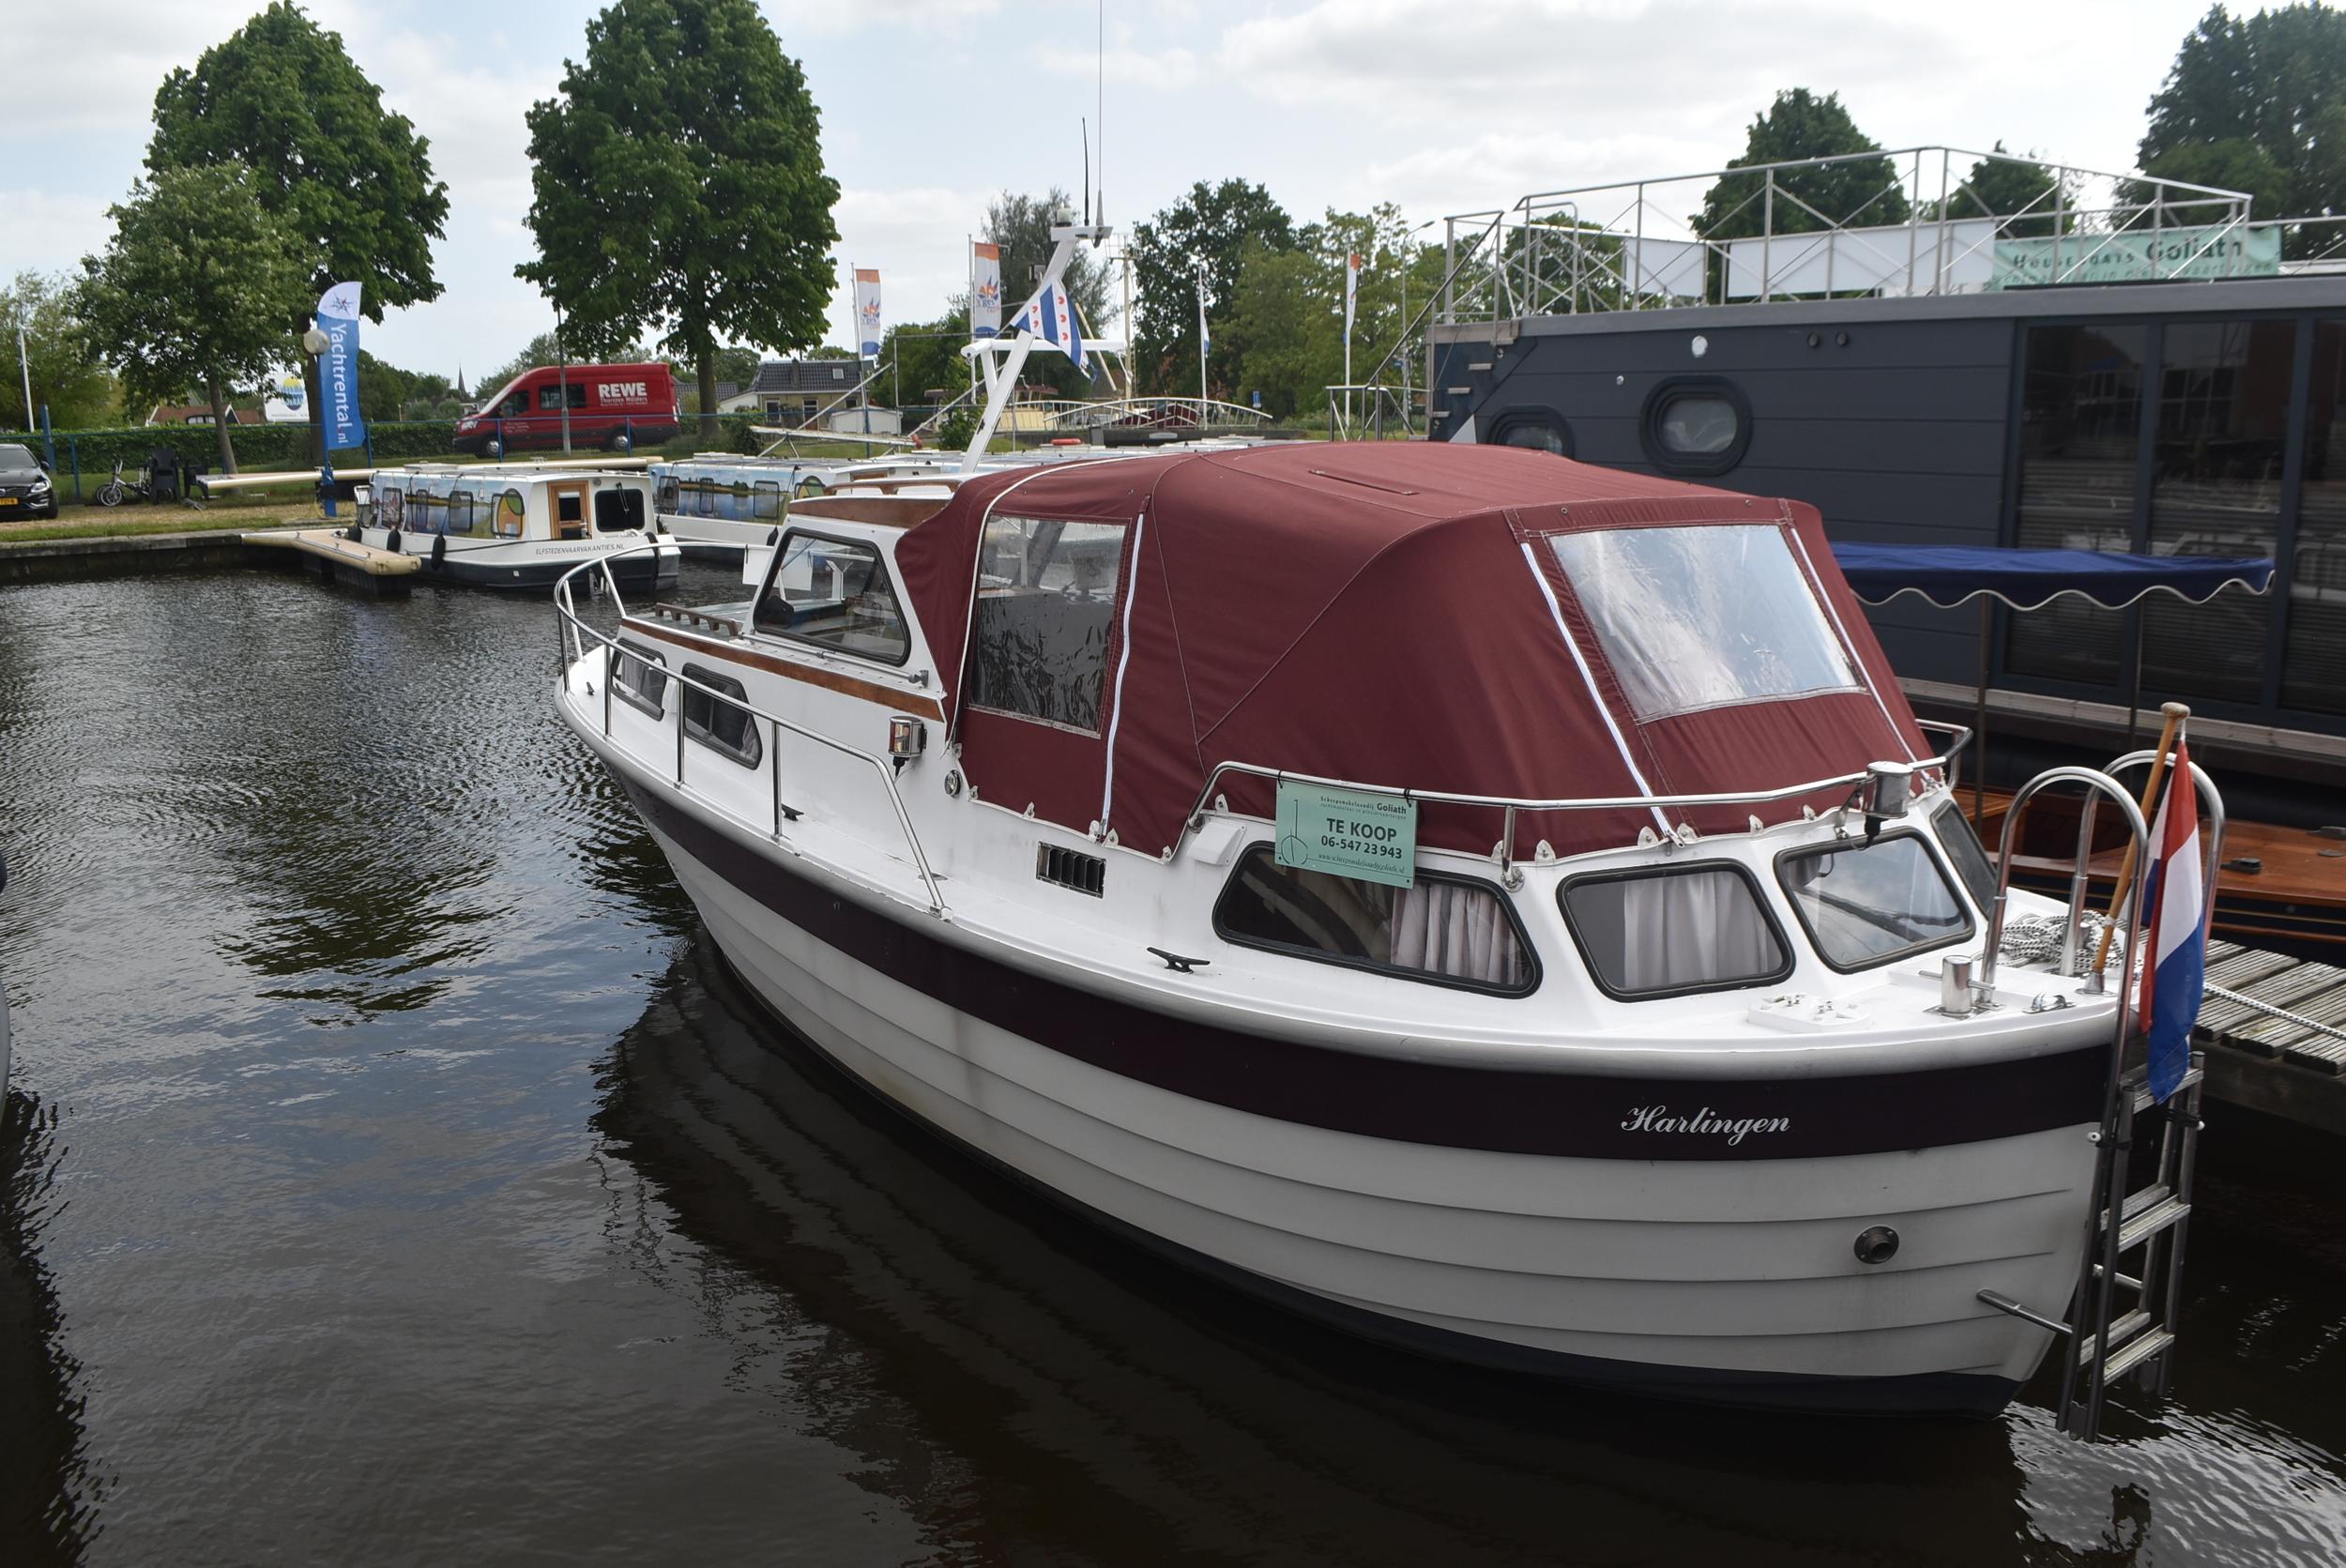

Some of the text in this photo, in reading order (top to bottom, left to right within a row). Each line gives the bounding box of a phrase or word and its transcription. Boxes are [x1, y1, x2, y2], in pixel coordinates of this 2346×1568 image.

[2013, 253, 2135, 269] HOUEOATS
[330, 324, 353, 443] Yachtrental.nl
[598, 382, 647, 398] REWE
[535, 543, 625, 556] ELFSTEDENVAARVAKANTIES.NL
[1377, 802, 1407, 814] Goliath
[1326, 817, 1397, 842] TE KOOP
[1621, 1104, 1790, 1147] Harlingen
